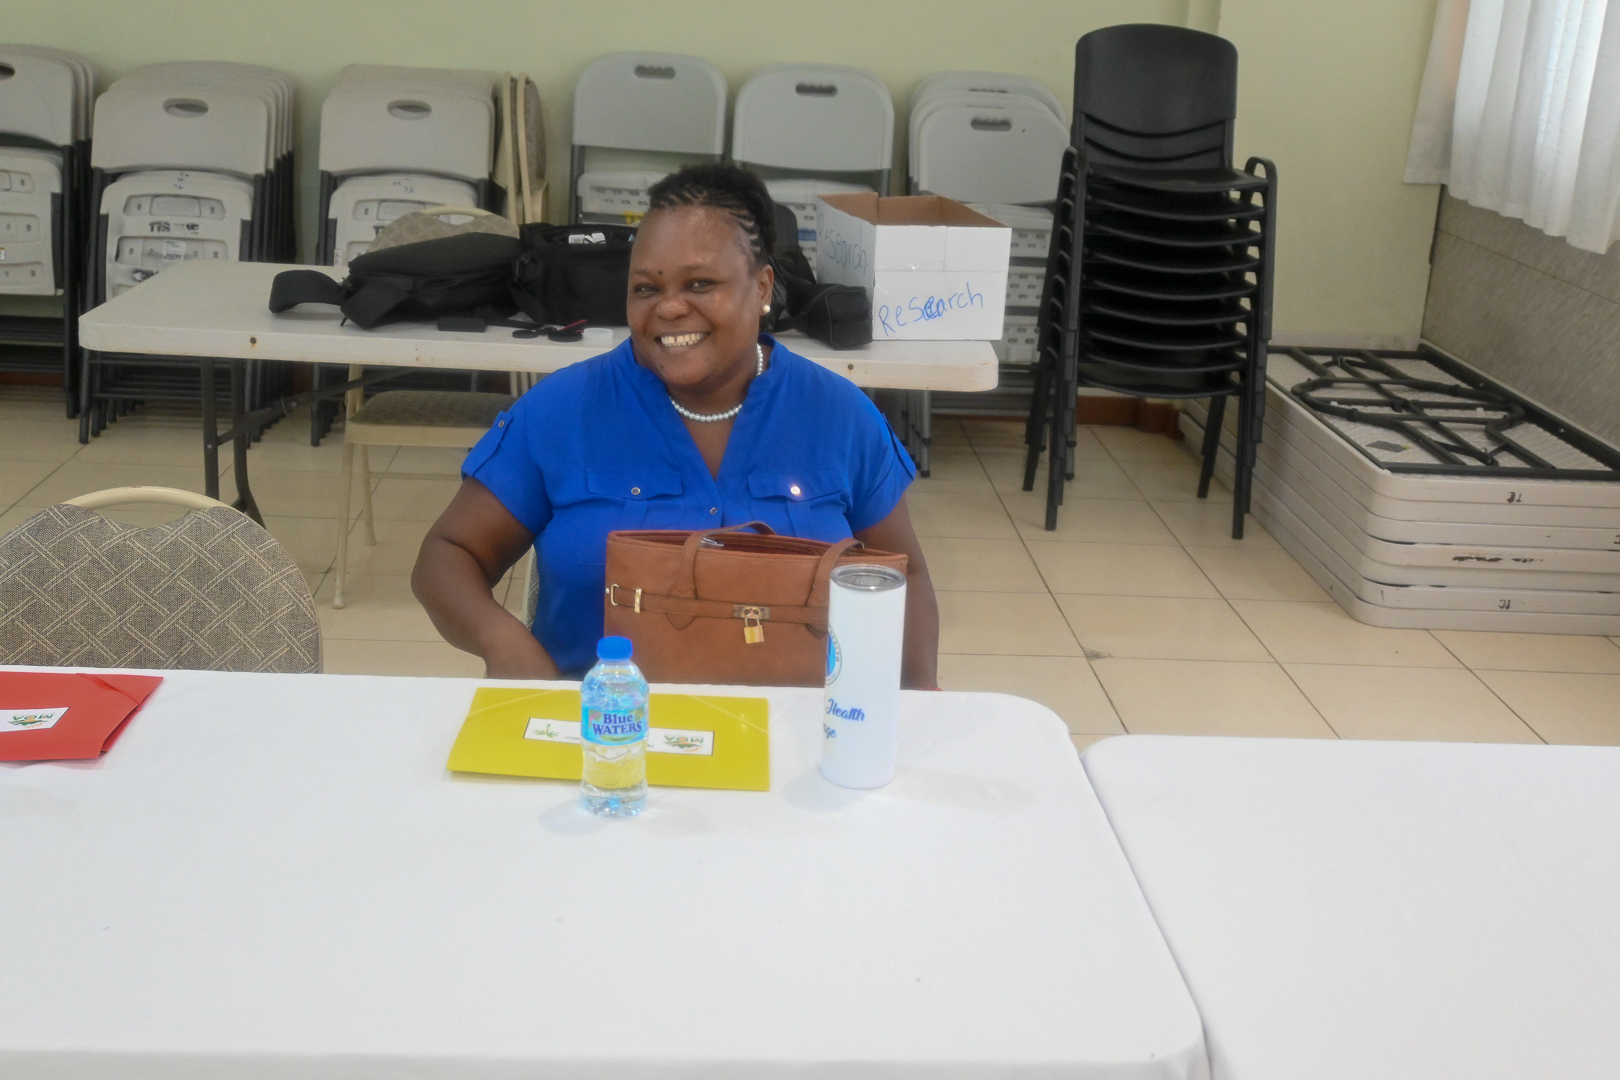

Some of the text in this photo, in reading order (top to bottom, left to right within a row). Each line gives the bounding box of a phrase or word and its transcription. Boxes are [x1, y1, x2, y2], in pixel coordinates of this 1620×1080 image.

[826, 698, 865, 722] Health
[12, 713, 54, 721] MOA
[603, 713, 633, 724] Blue
[592, 720, 642, 736] WATERS
[663, 735, 705, 744] MOA
